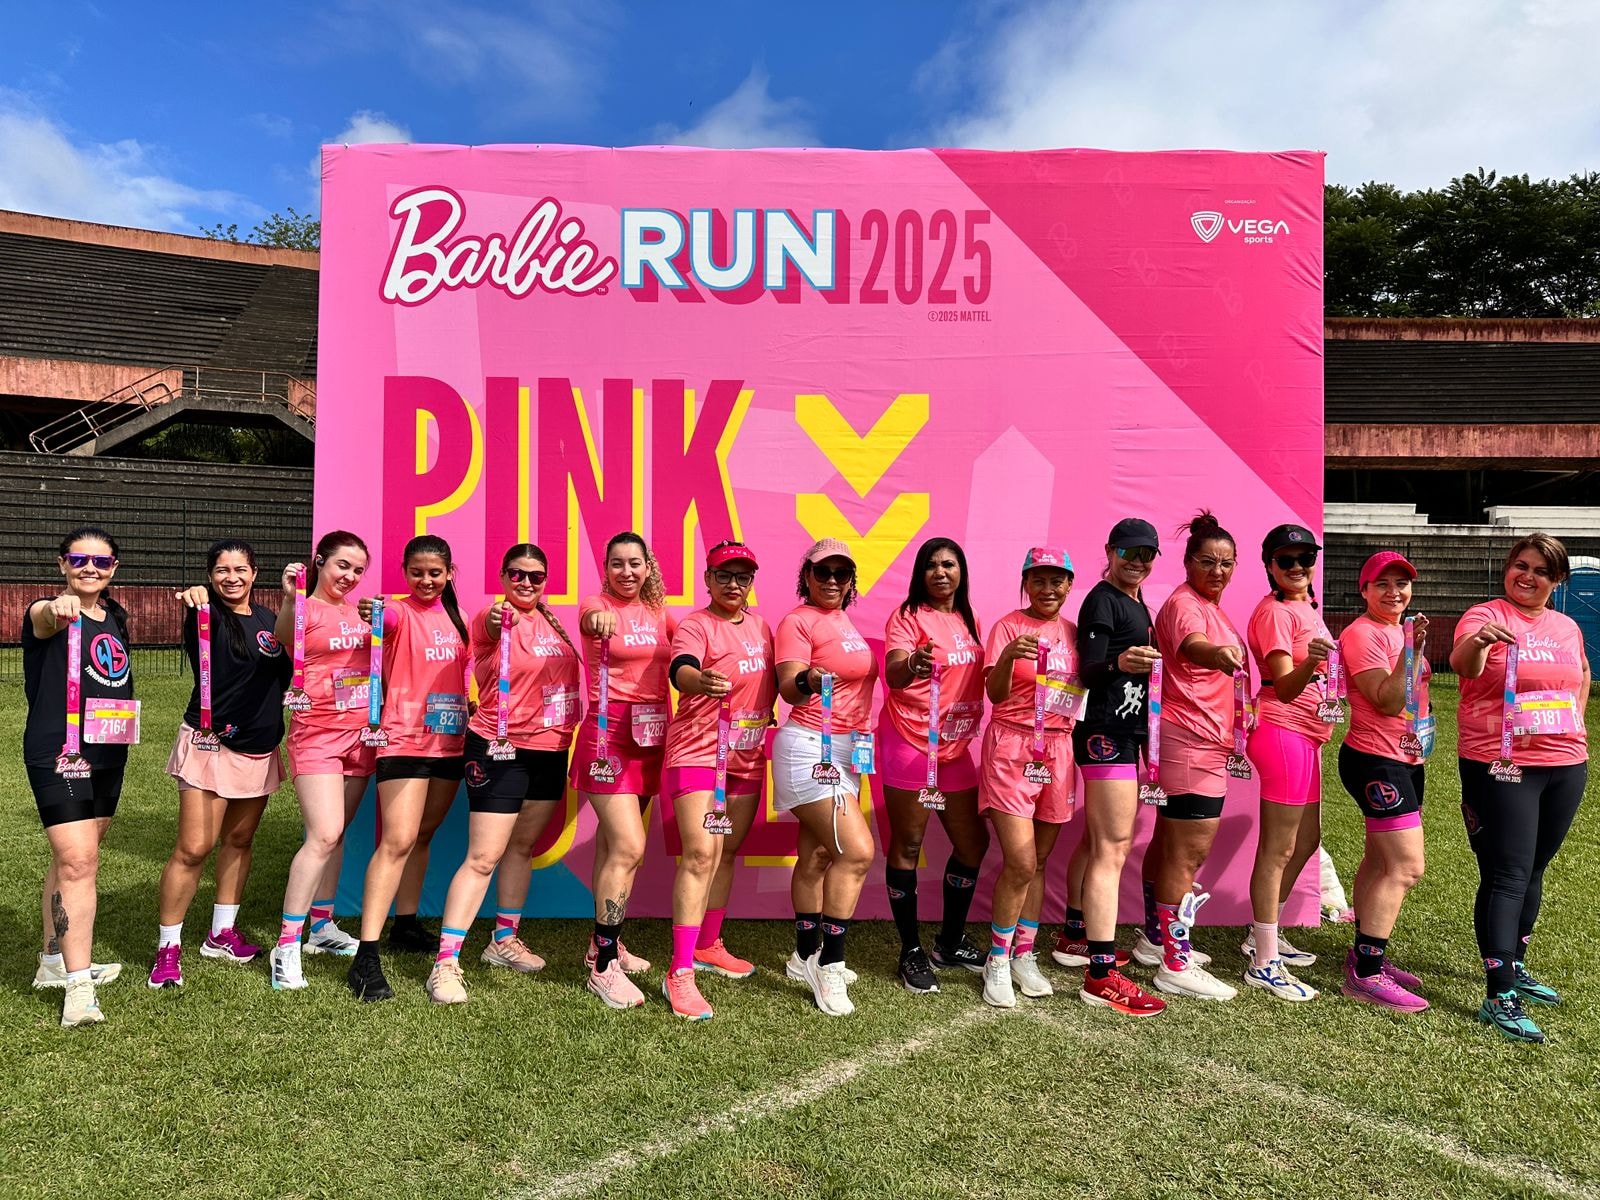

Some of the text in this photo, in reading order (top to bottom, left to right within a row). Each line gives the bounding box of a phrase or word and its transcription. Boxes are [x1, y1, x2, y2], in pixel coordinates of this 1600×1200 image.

[1227, 219, 1290, 234] VEGA
[382, 188, 992, 304] Barbie RUN 2025
[1244, 236, 1273, 244] sports
[960, 310, 992, 322] MATTEL.
[381, 376, 752, 602] PINK
[340, 621, 372, 634] Barbie
[629, 620, 658, 634] Barbie
[329, 637, 364, 650] RUN
[433, 630, 462, 645] Barbie
[623, 634, 658, 646] RUN
[1526, 632, 1560, 648] Barbie
[533, 646, 562, 657] RUN
[840, 641, 868, 653] RUN
[1046, 641, 1072, 654] arbie
[425, 648, 456, 661] RUN
[948, 652, 976, 666] RUN
[1517, 650, 1554, 662] RUN
[738, 658, 766, 674] RUN
[1034, 656, 1067, 671] UN
[1330, 664, 1338, 679] RUN
[283, 692, 311, 706] Barbie
[350, 685, 370, 700] 333
[1046, 688, 1074, 708] 2675
[1318, 703, 1344, 717] Barbie
[440, 711, 462, 726] 8216
[954, 718, 974, 732] 1257
[1532, 710, 1560, 726] 3181
[101, 720, 127, 735] 2164
[360, 728, 388, 740] Barbie
[644, 722, 664, 737] 4282
[193, 732, 220, 744] Barbie
[1400, 736, 1422, 750] Barbie
[486, 740, 516, 756] Barbie
[718, 744, 726, 760] RUN
[55, 757, 91, 774] Barbie
[589, 762, 615, 776] Barbie
[813, 764, 840, 778] Barbie
[1024, 762, 1051, 777] Barbie
[1226, 757, 1250, 771] Barbie
[1488, 760, 1522, 775] Barbie
[918, 788, 946, 803] Barbie
[1139, 785, 1167, 799] Barbie
[704, 814, 732, 828] Barbie
[955, 948, 978, 960] FILA
[1100, 987, 1130, 1006] FILA
